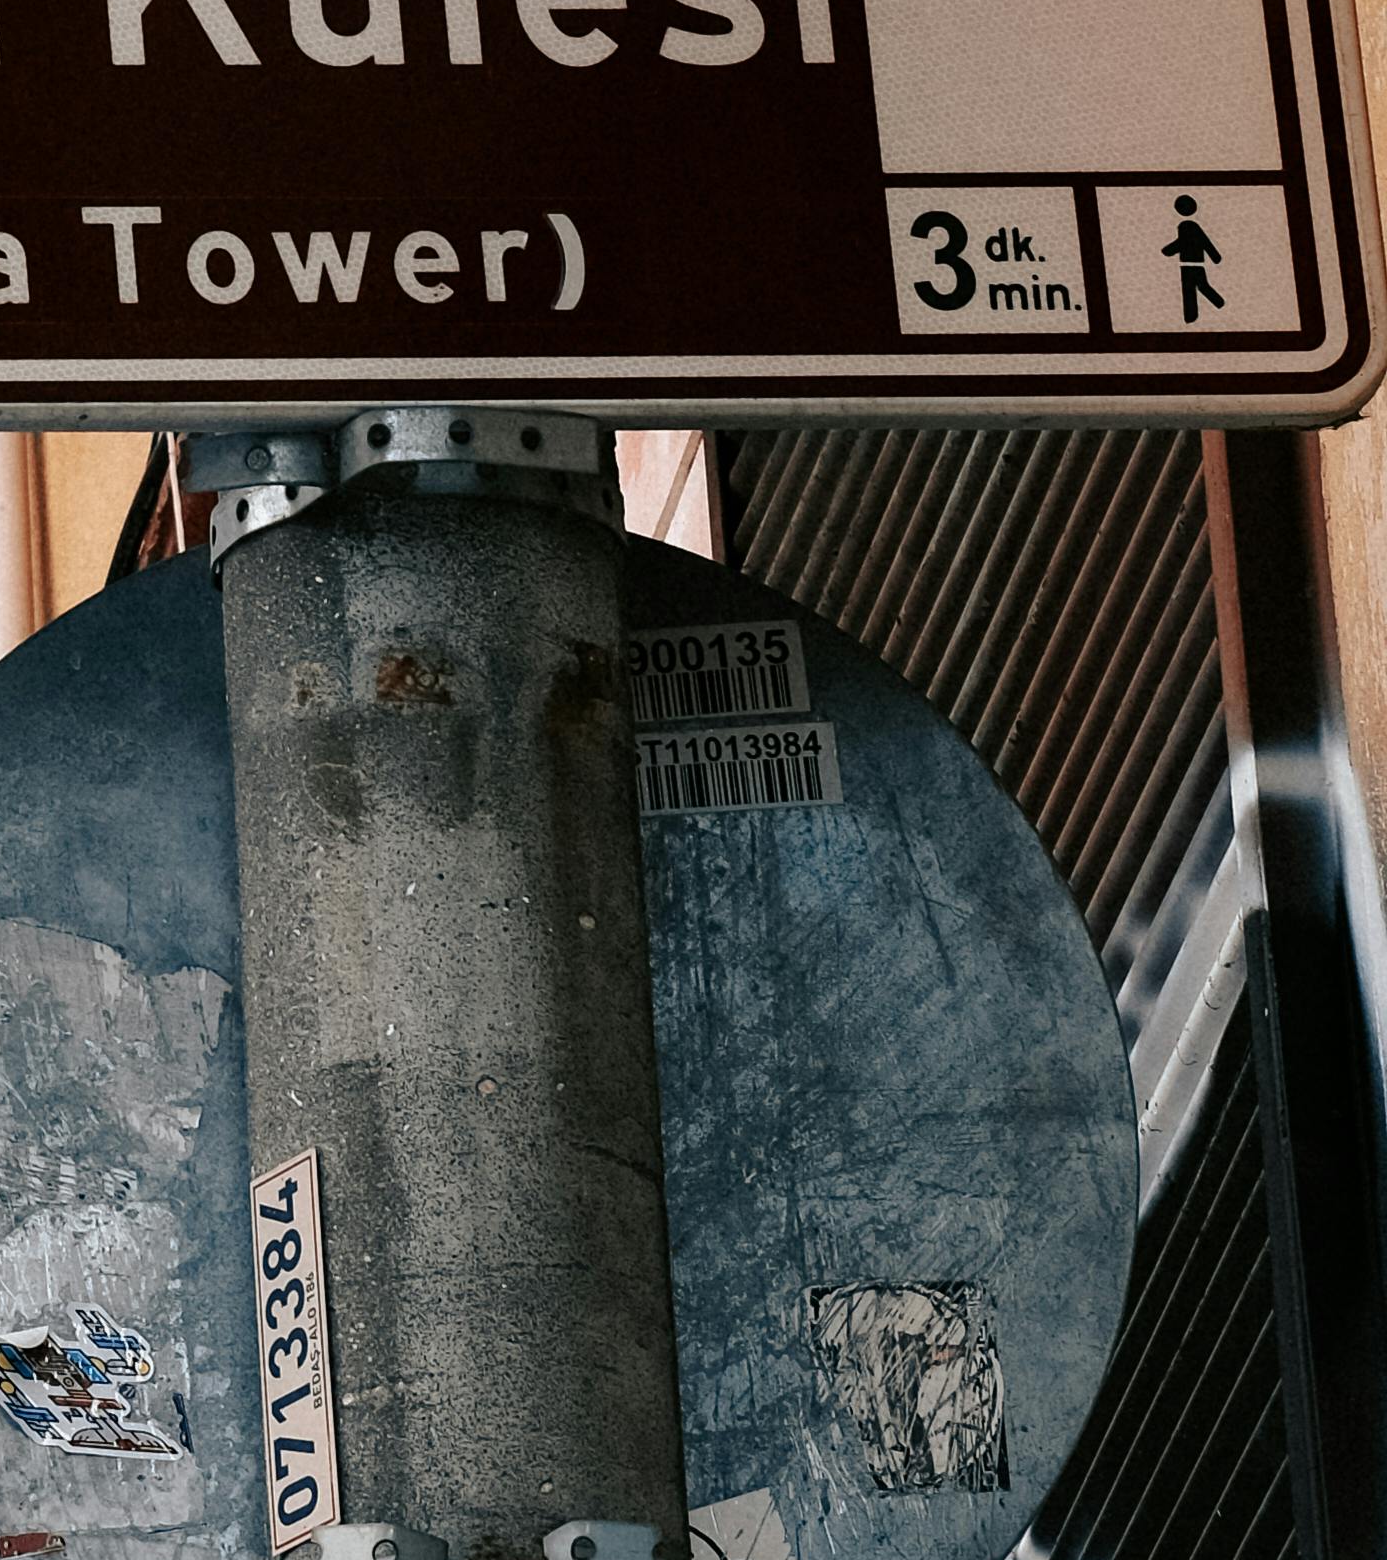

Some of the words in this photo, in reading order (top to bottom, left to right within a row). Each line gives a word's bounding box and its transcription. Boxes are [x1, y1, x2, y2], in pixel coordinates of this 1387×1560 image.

[81, 205, 586, 311] Tower)
[909, 210, 978, 312] 3
[984, 226, 1047, 264] dk.
[988, 274, 1084, 312] min.
[259, 1176, 320, 1527] 0713384
